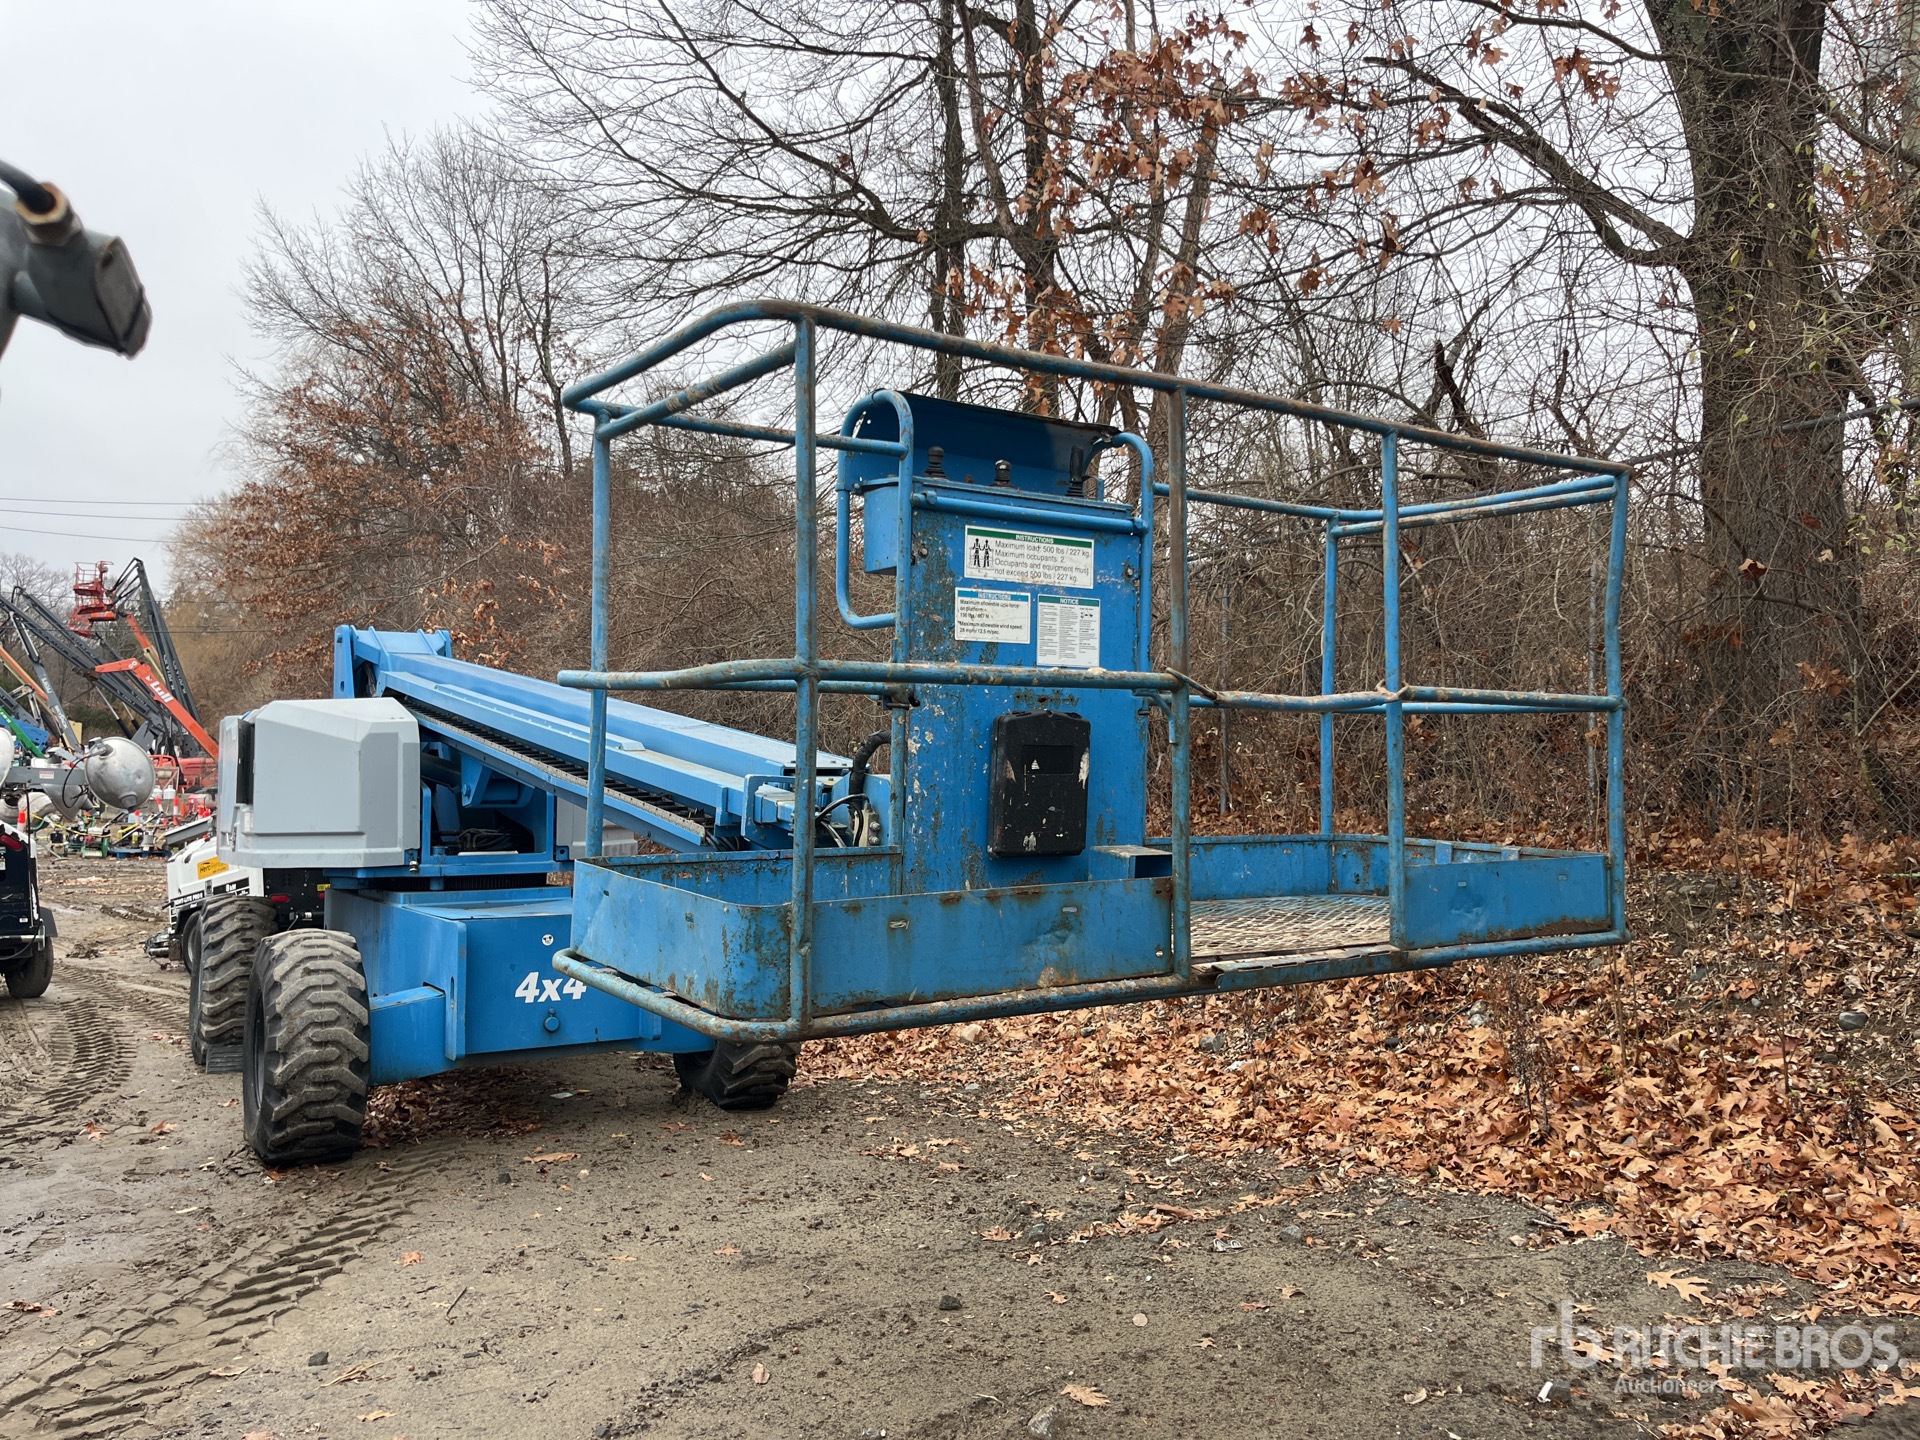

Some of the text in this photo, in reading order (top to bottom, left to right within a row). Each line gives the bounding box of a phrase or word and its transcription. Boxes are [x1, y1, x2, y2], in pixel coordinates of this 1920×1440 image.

[1015, 534, 1054, 544] INSTRUCTIONS
[995, 540, 1025, 550] Maximum
[1043, 545, 1054, 553] 500
[995, 550, 1025, 558] Maximum
[995, 559, 1028, 571] Occupants
[1029, 562, 1041, 570] and
[1042, 563, 1074, 575] equipment
[1006, 569, 1028, 578] exceed
[1030, 571, 1042, 579] 500
[514, 971, 587, 1003] 4x4
